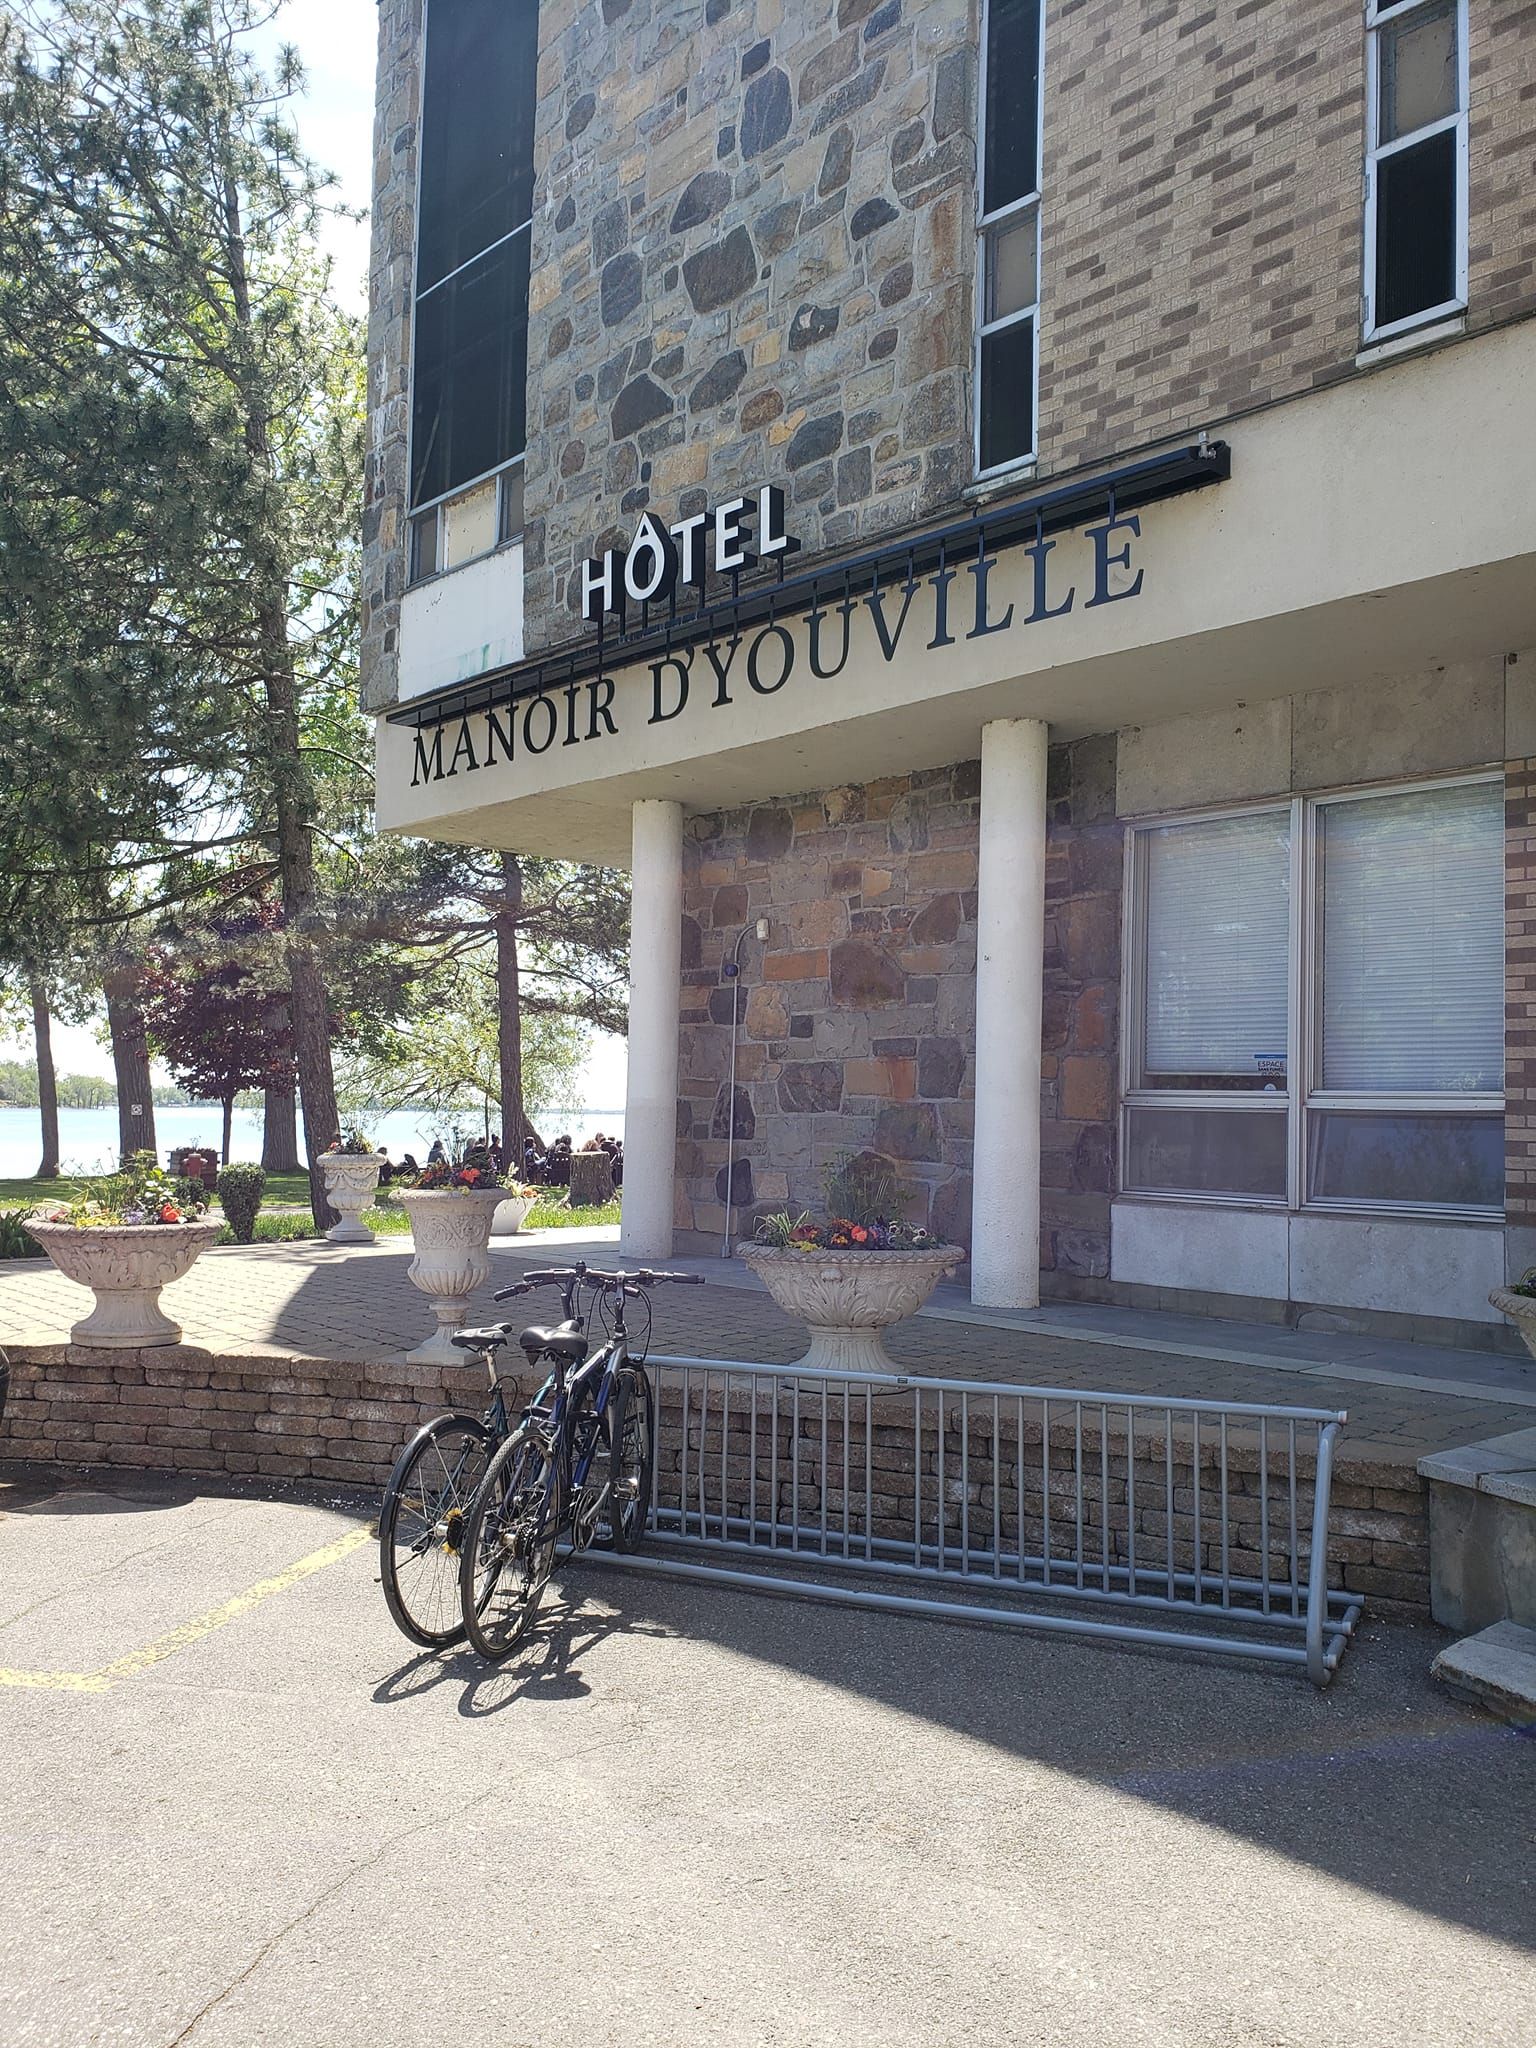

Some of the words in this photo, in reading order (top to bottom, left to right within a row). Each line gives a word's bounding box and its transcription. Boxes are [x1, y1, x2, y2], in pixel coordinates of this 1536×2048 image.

[582, 485, 790, 620] HÔTEL
[411, 678, 619, 786] MANOIR
[647, 513, 1145, 724] D'YOUVILLE
[1257, 1060, 1284, 1068] ESPACE
